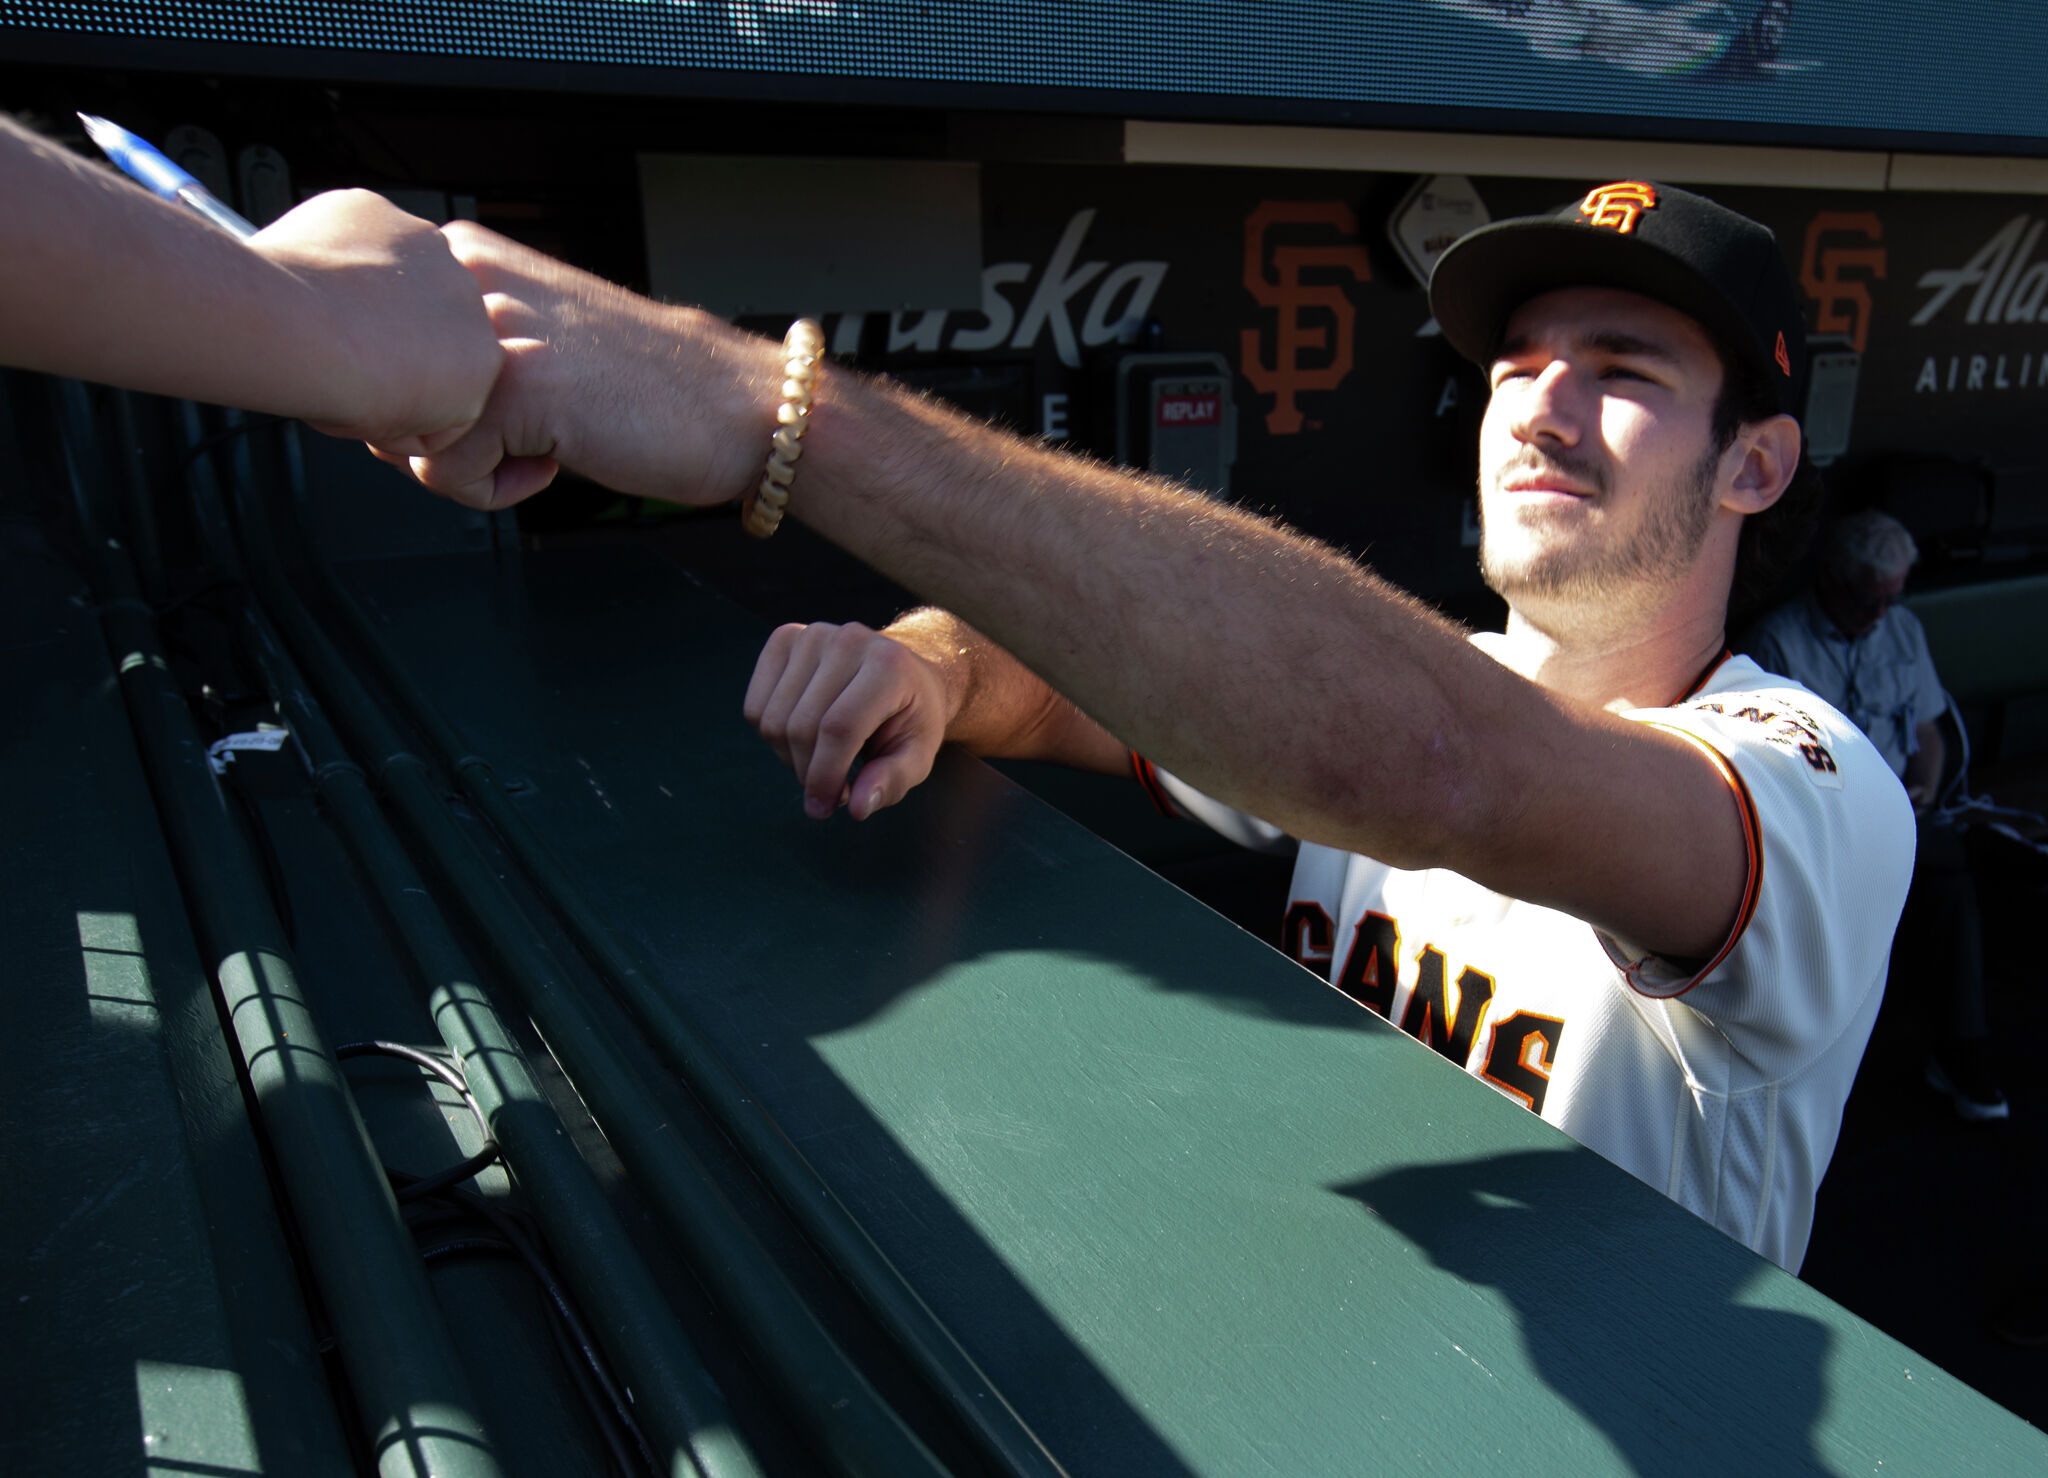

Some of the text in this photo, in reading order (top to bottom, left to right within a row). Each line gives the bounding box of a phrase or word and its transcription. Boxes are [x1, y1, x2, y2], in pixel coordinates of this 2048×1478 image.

[1239, 199, 1374, 436] SF
[1909, 212, 2048, 326] Ala
[1161, 400, 1217, 421] REPLAY
